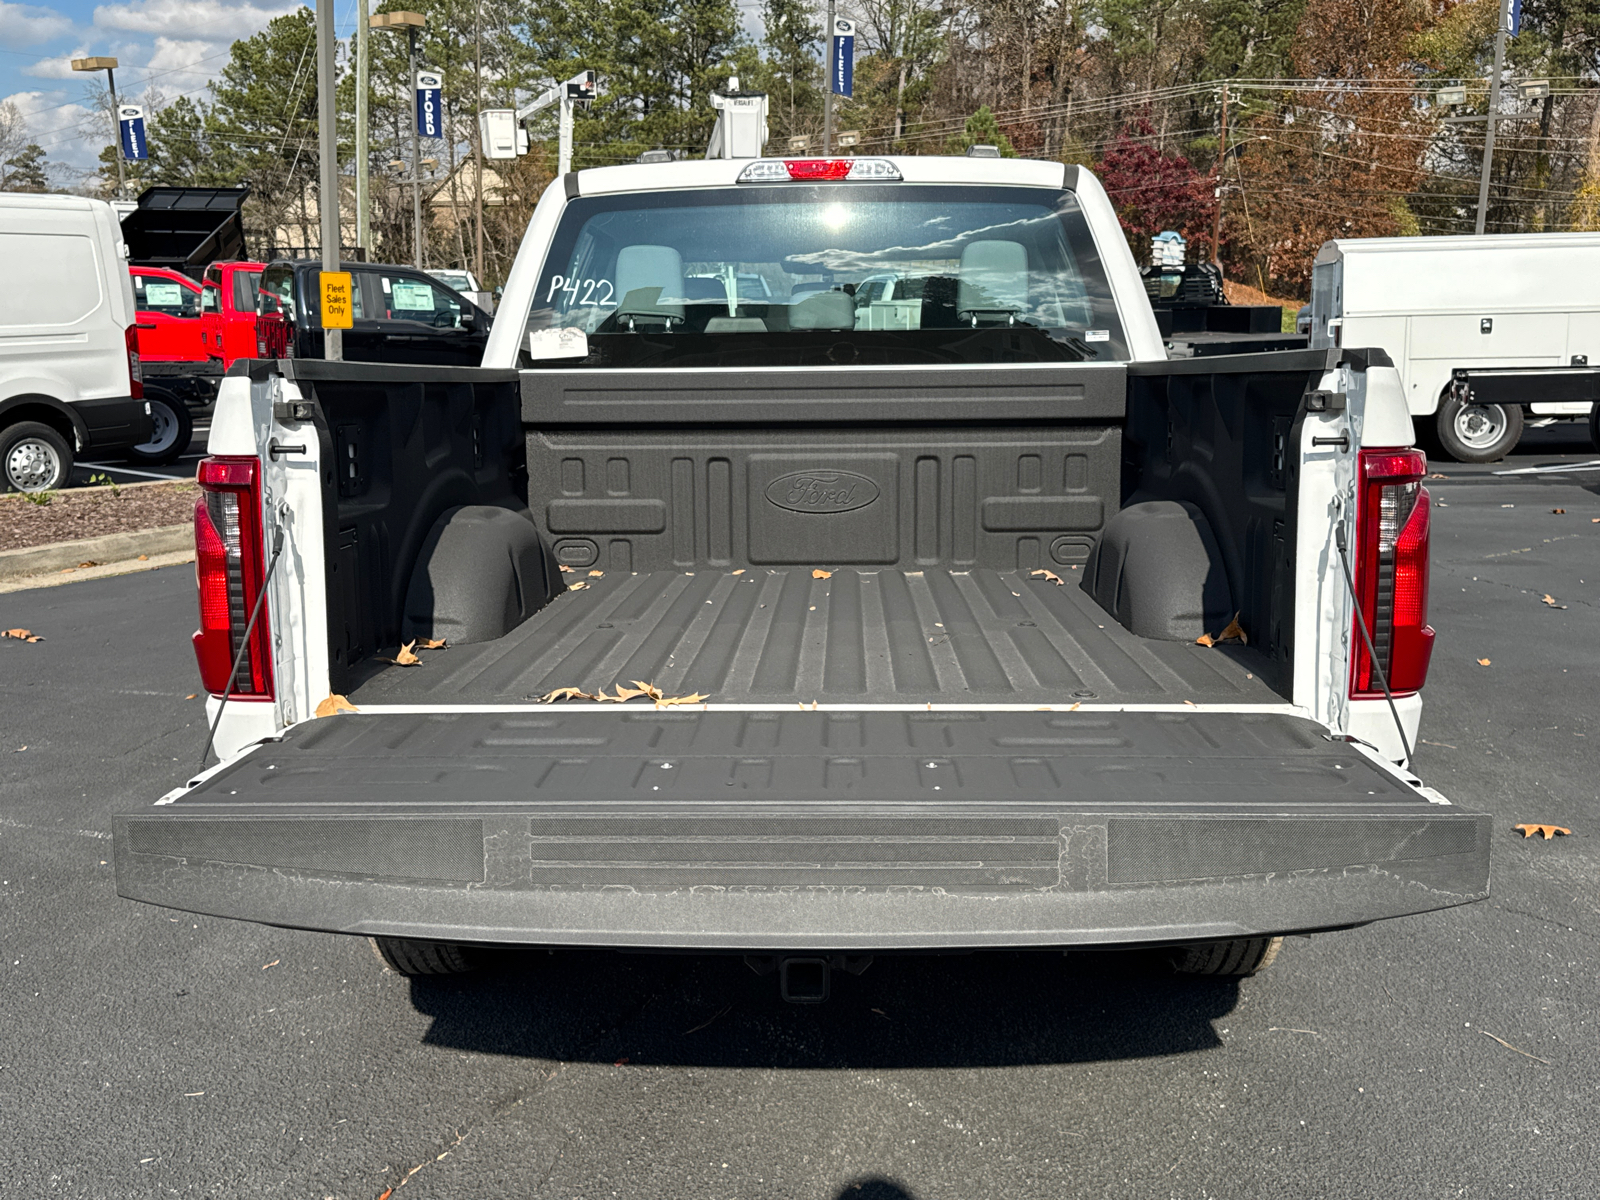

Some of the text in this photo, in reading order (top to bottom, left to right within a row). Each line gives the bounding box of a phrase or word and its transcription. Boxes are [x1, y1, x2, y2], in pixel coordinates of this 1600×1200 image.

[424, 90, 435, 135] FORD
[128, 120, 139, 158] FLEET
[326, 283, 345, 293] Fleet
[326, 294, 347, 304] Sales
[546, 274, 618, 306] P422
[328, 305, 345, 317] Only
[786, 475, 857, 505] Ford
